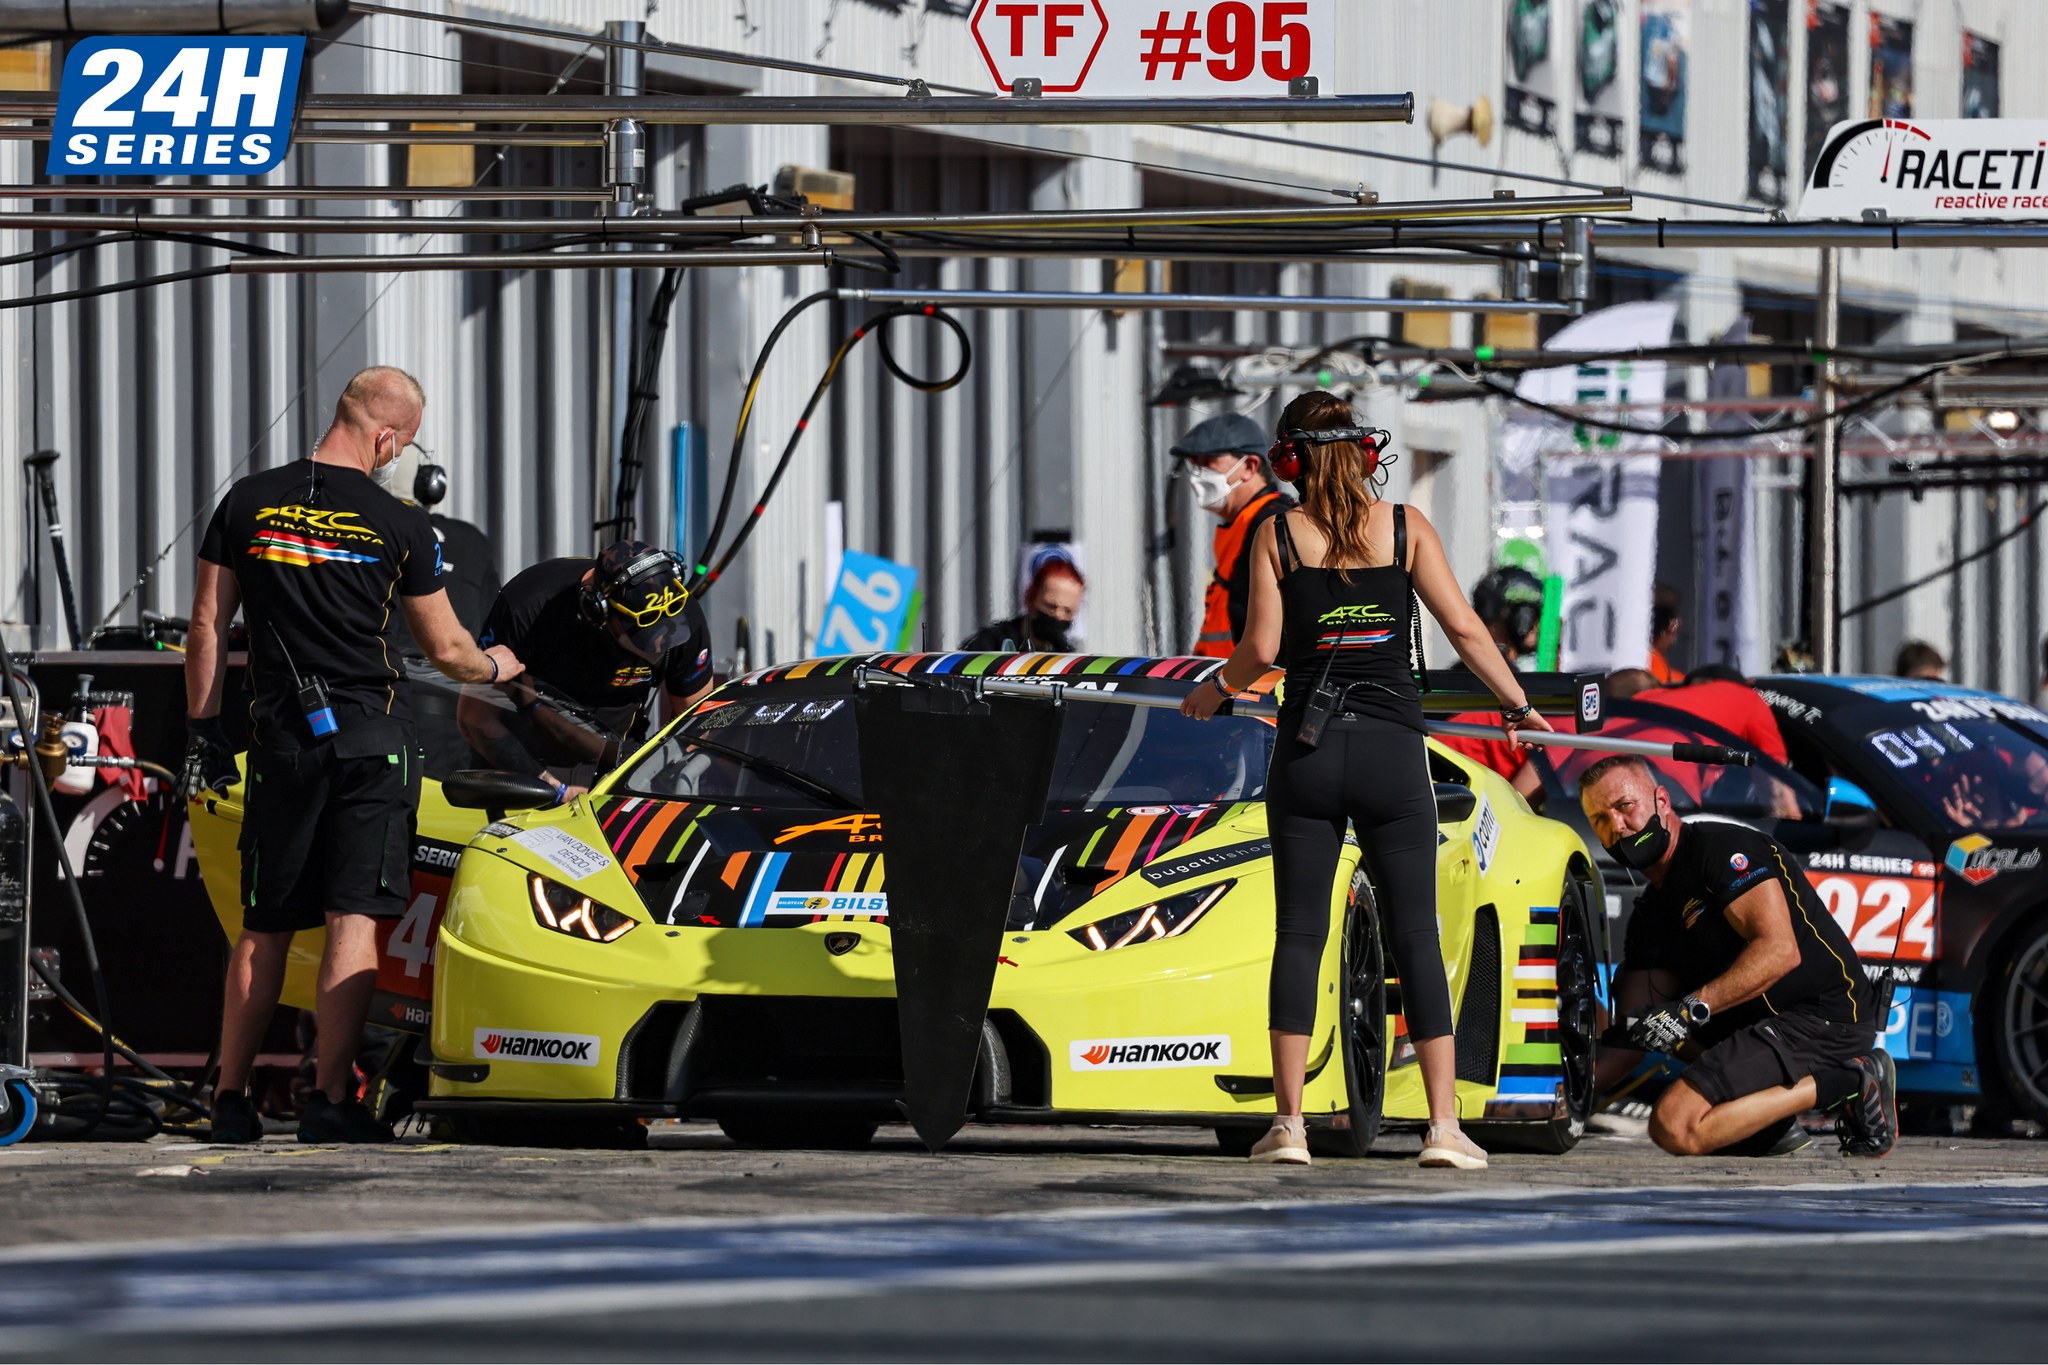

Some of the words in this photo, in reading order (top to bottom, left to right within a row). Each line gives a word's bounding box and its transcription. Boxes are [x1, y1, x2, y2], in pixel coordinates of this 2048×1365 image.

[996, 4, 1084, 56] TF
[1140, 1, 1310, 81] #95
[1935, 193, 2008, 209] reactive
[269, 519, 385, 545] BRATISLAVA
[1147, 843, 1272, 880] bugattishoe
[1808, 852, 1845, 869] 24H
[1849, 854, 1914, 875] SERIES
[832, 897, 889, 910] BILS
